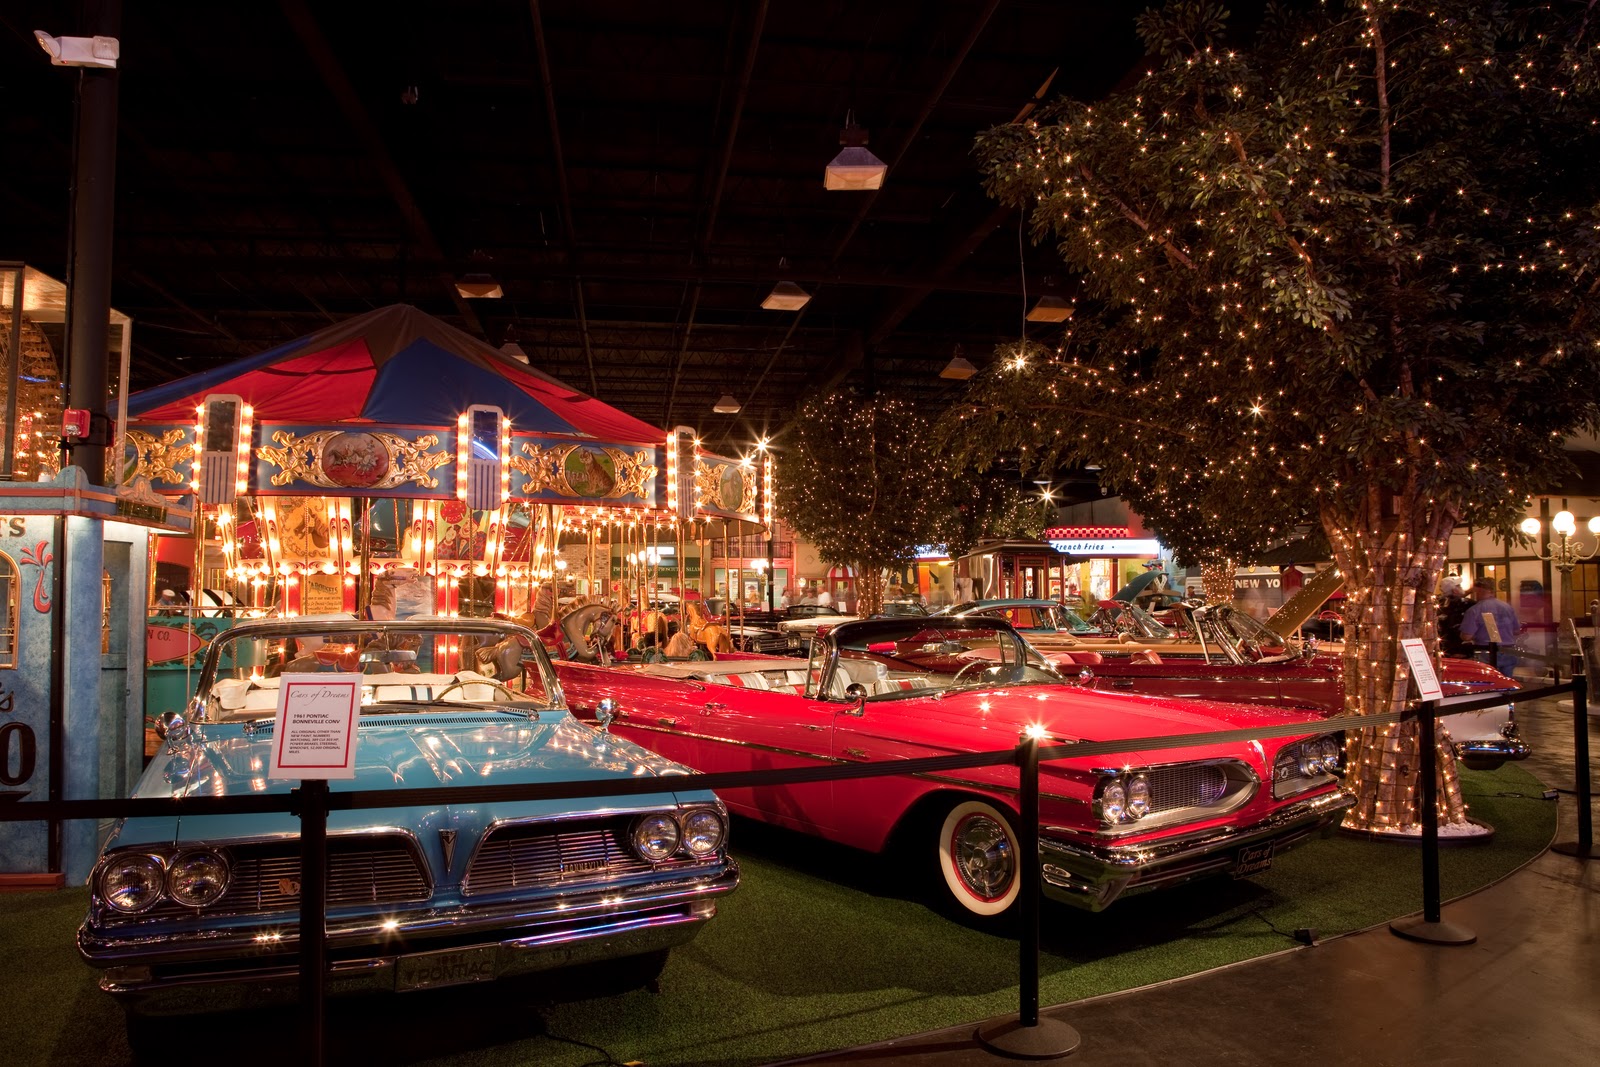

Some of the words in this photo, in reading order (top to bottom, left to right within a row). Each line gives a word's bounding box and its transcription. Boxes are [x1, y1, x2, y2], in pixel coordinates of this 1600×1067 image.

[1084, 543, 1105, 551] Fries
[1235, 579, 1260, 589] NEW
[290, 690, 308, 699] Cars
[303, 686, 327, 707] of
[322, 690, 350, 699] Dreams
[1241, 850, 1263, 863] Cars
[1237, 857, 1272, 874] Dreams
[418, 960, 491, 982] PONTIAC
